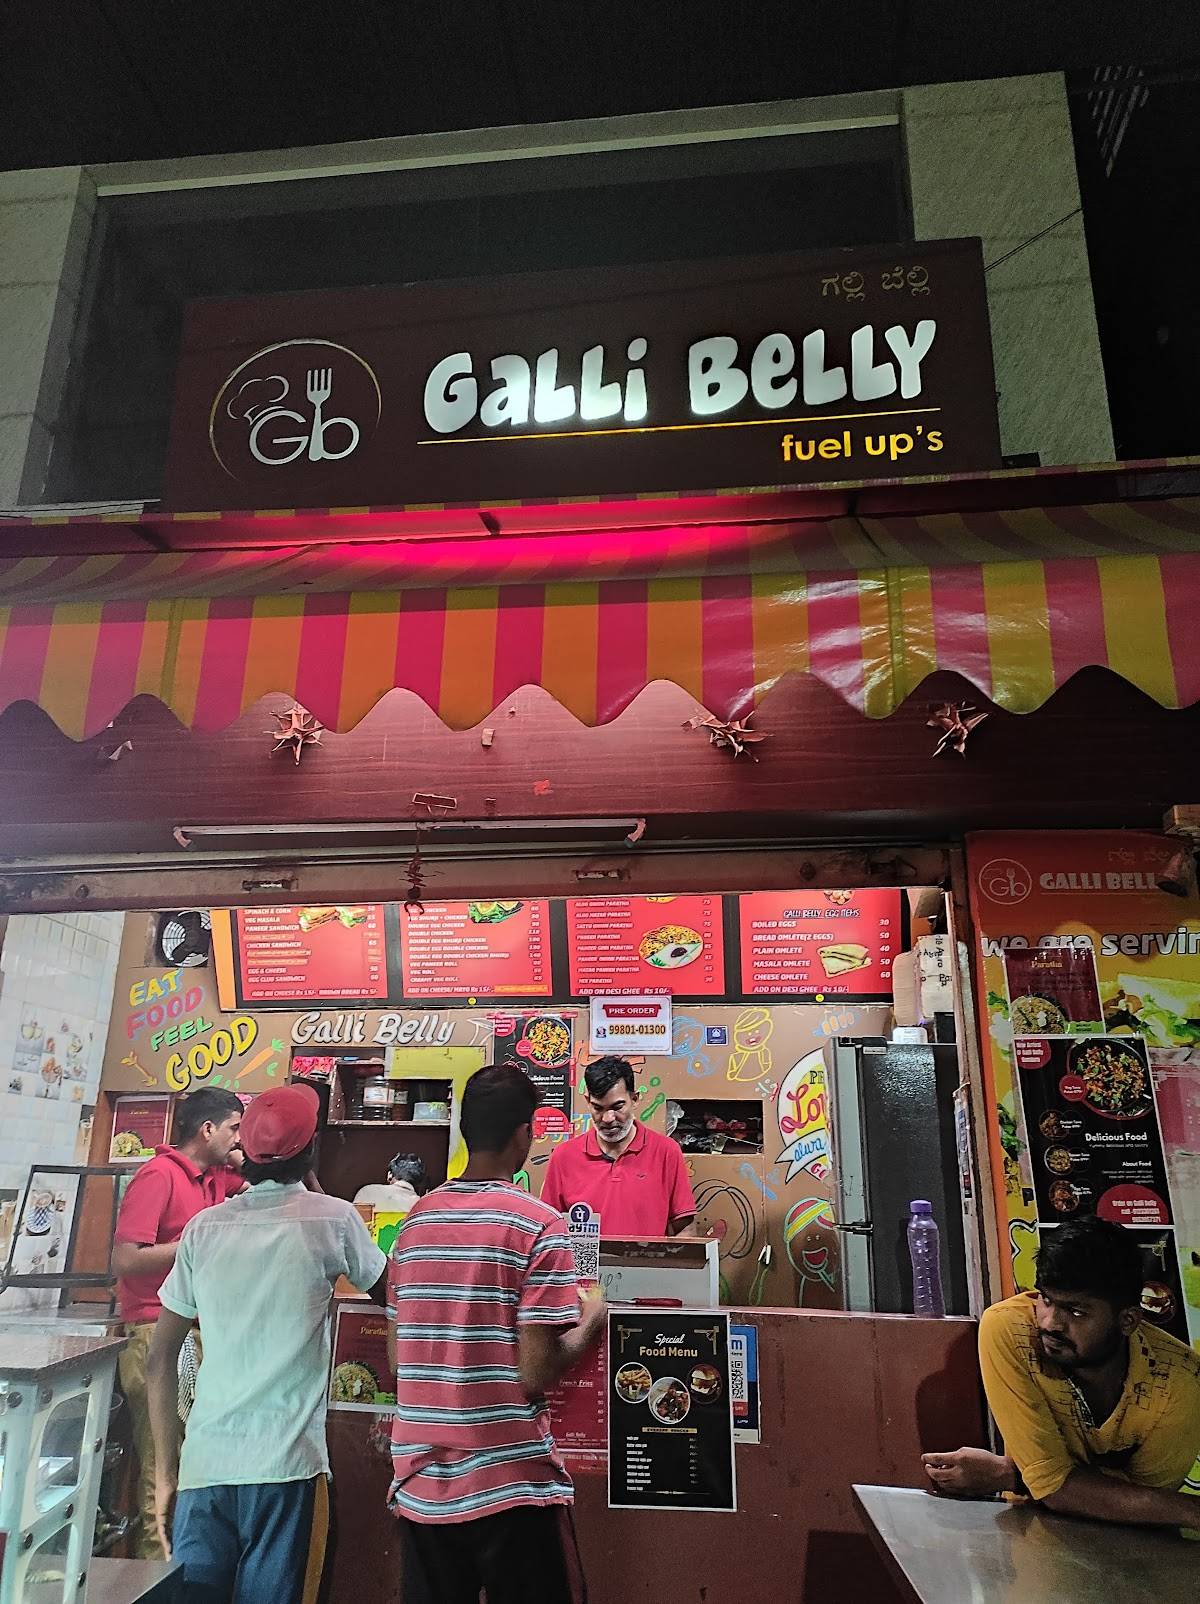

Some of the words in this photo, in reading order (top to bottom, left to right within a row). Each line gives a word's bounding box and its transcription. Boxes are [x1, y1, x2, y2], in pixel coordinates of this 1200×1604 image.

[821, 272, 865, 302] ಗಲ್ಲಿ
[782, 426, 851, 462] fuel
[864, 425, 944, 459] up's
[1040, 872, 1101, 889] GALLI
[129, 968, 180, 1007] EAT
[126, 985, 204, 1040] FOOD
[150, 1016, 214, 1052] FEEL
[291, 1012, 366, 1044] Galli
[373, 1014, 455, 1046] Belly
[609, 1025, 666, 1035] 99801-01300
[165, 1015, 258, 1092] GOOD
[1085, 1132, 1124, 1141] Delicious
[1125, 1132, 1147, 1140] Food
[569, 1223, 598, 1232] aytm
[640, 1346, 666, 1357] Food
[668, 1346, 698, 1357] Menu
[654, 1333, 685, 1346] Special
